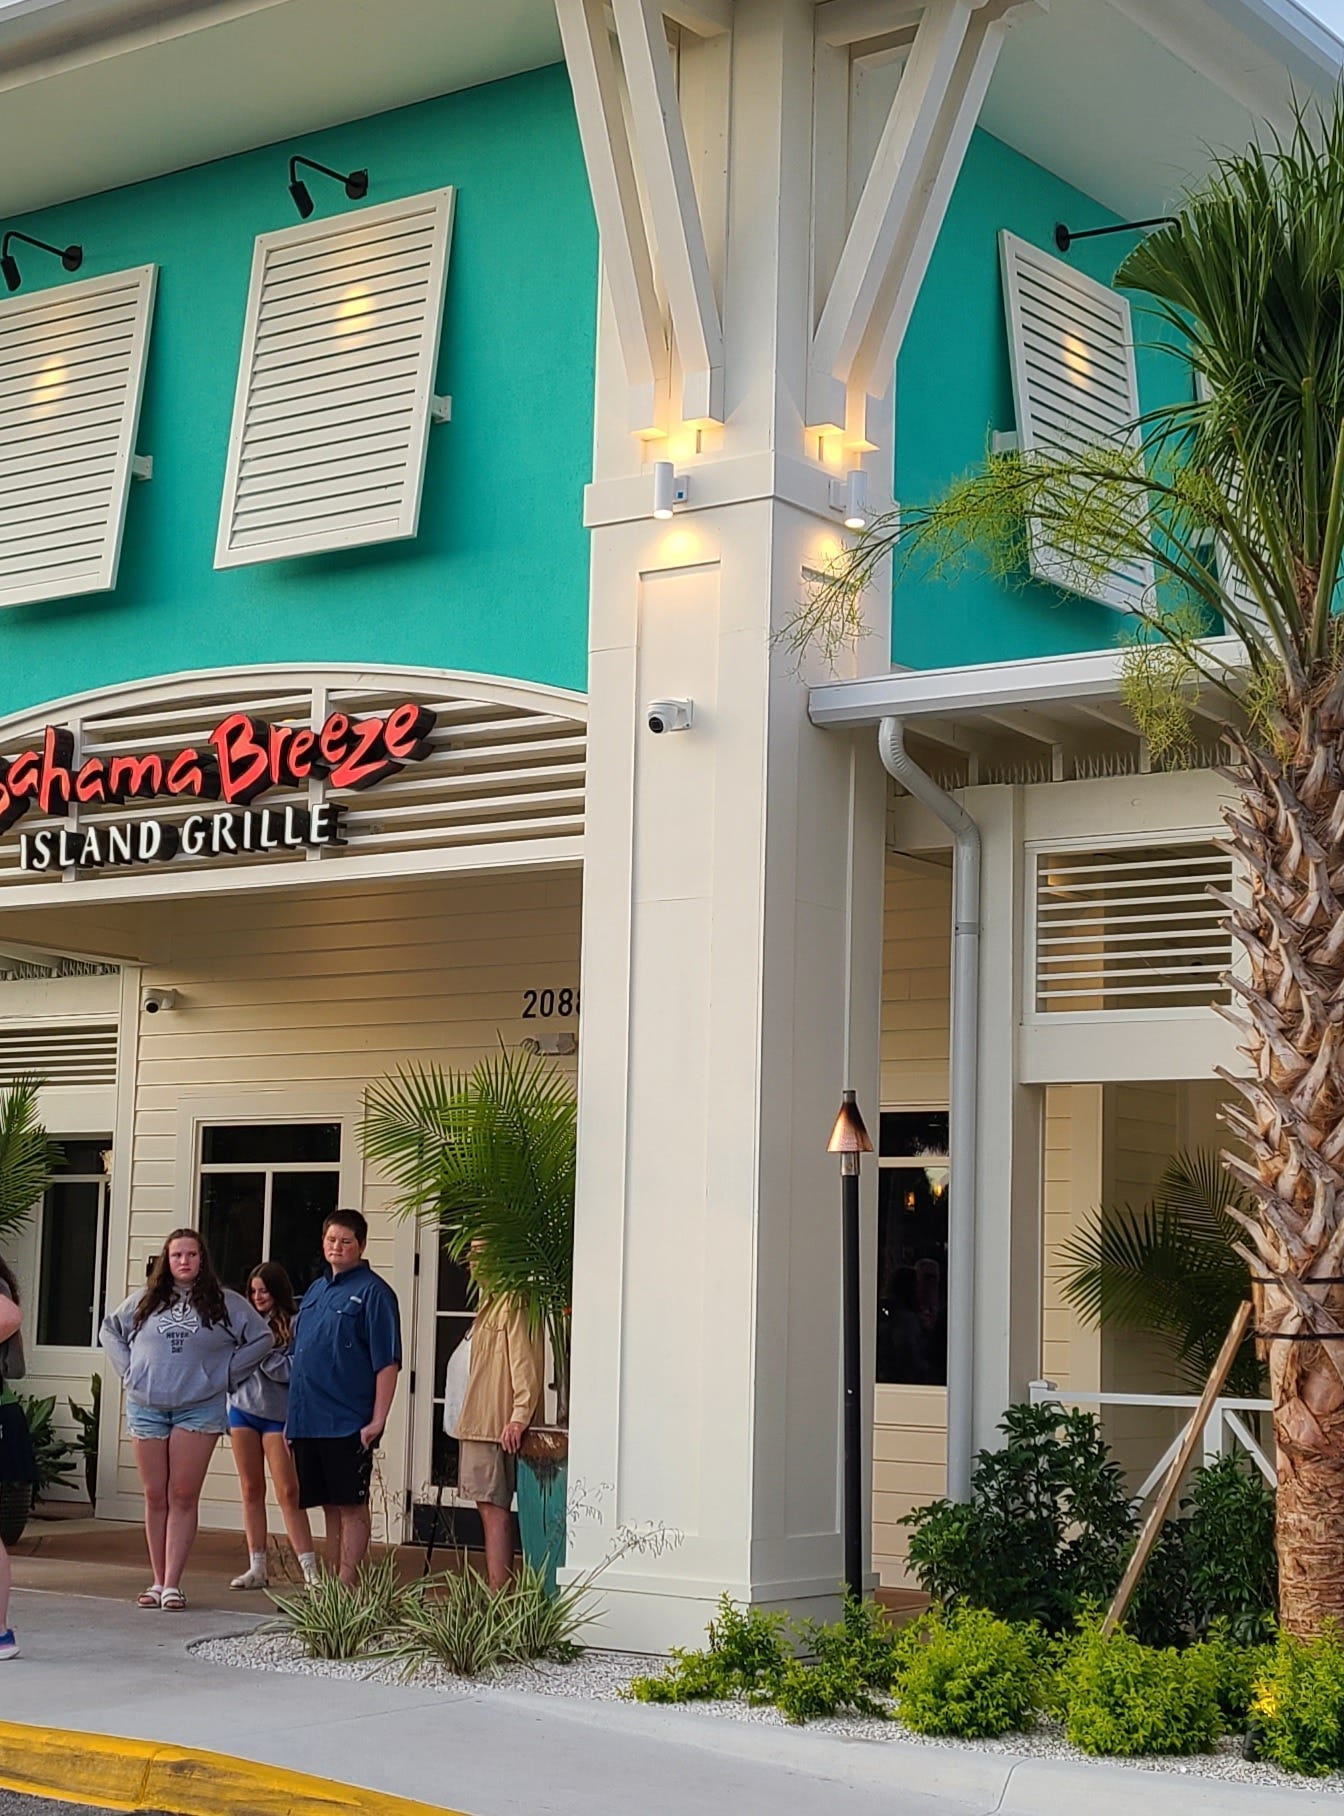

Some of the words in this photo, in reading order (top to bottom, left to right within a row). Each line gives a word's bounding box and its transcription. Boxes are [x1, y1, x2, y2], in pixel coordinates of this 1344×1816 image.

[209, 704, 424, 804] Breeze
[19, 820, 164, 872] ISLAND
[181, 803, 334, 856] GRILLE
[522, 988, 580, 1019] 208
